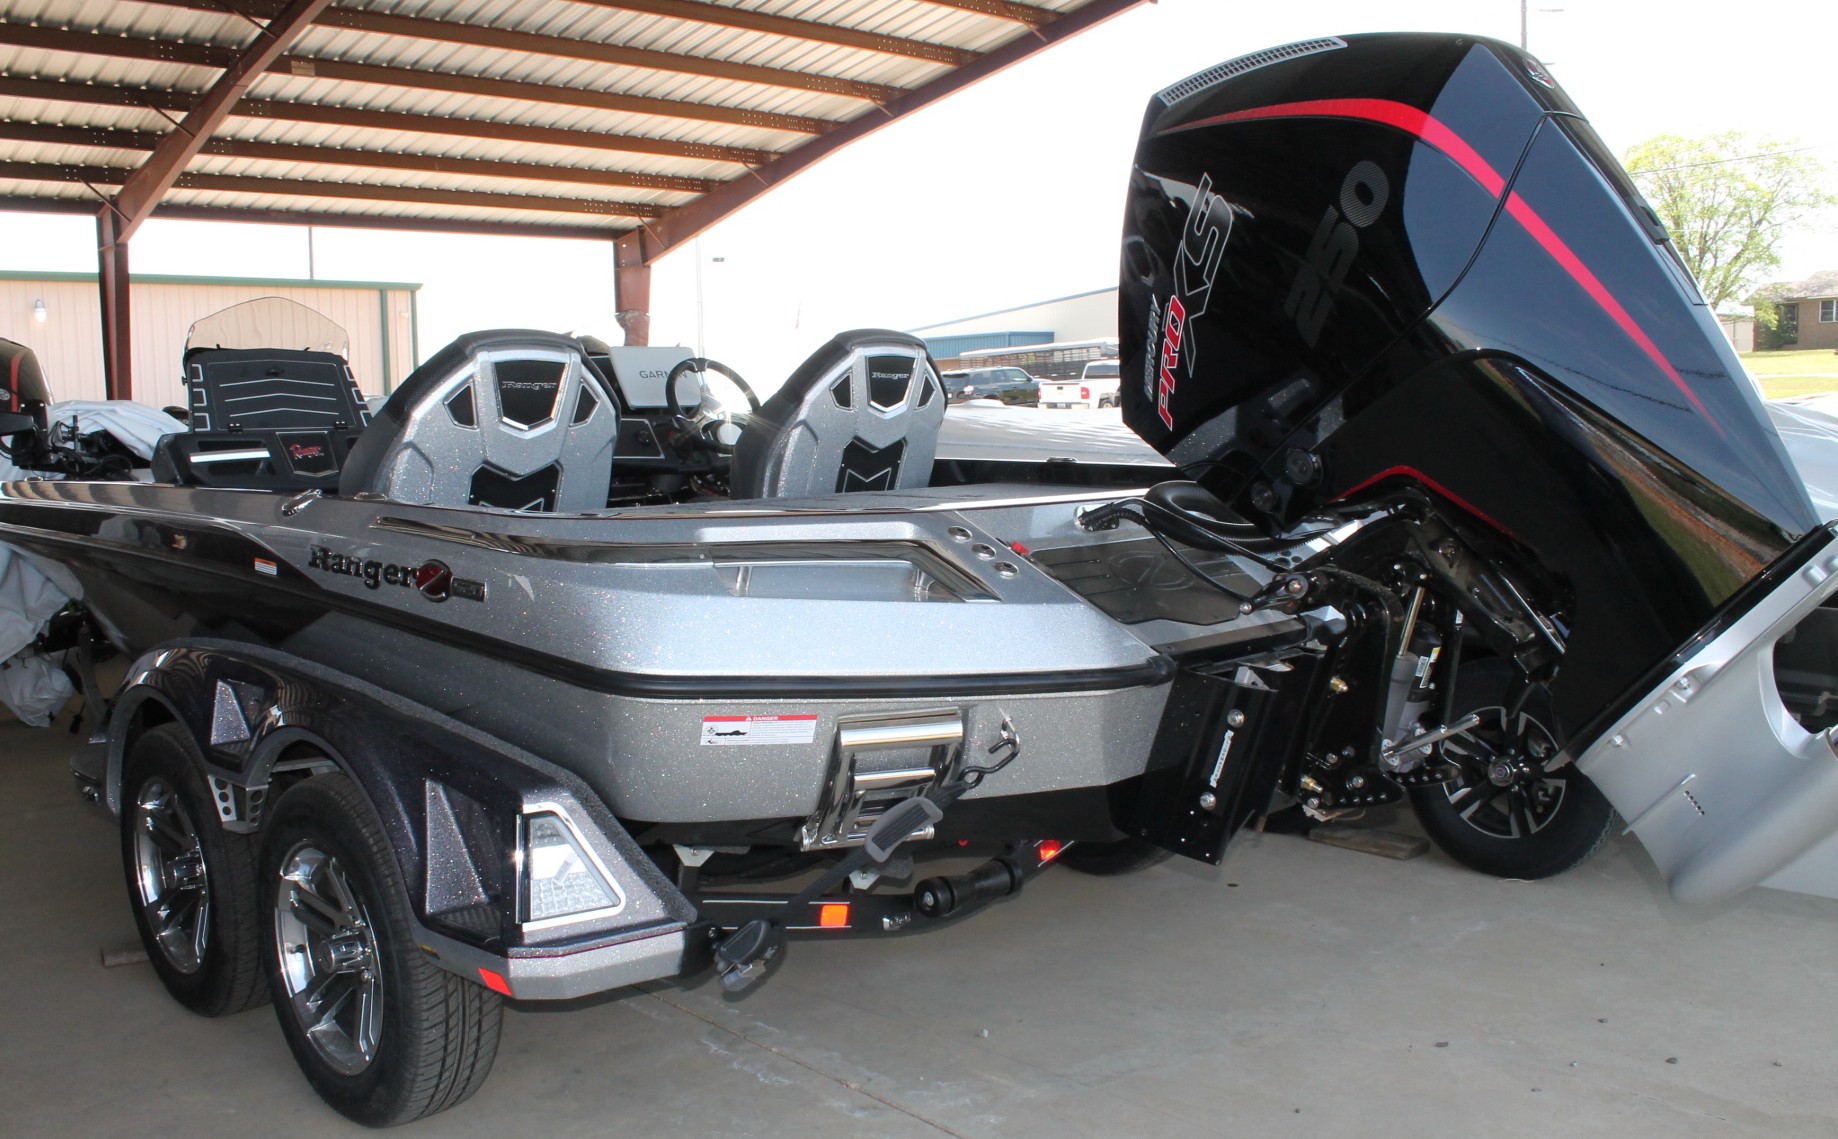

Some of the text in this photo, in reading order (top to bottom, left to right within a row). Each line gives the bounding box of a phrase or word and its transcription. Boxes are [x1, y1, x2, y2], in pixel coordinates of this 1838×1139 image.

[1284, 160, 1390, 349] 250
[639, 370, 688, 379] GARN
[871, 372, 910, 380] Ranger
[1158, 295, 1186, 431] PRO
[501, 381, 558, 391] Ranger
[308, 544, 417, 590] Ranger
